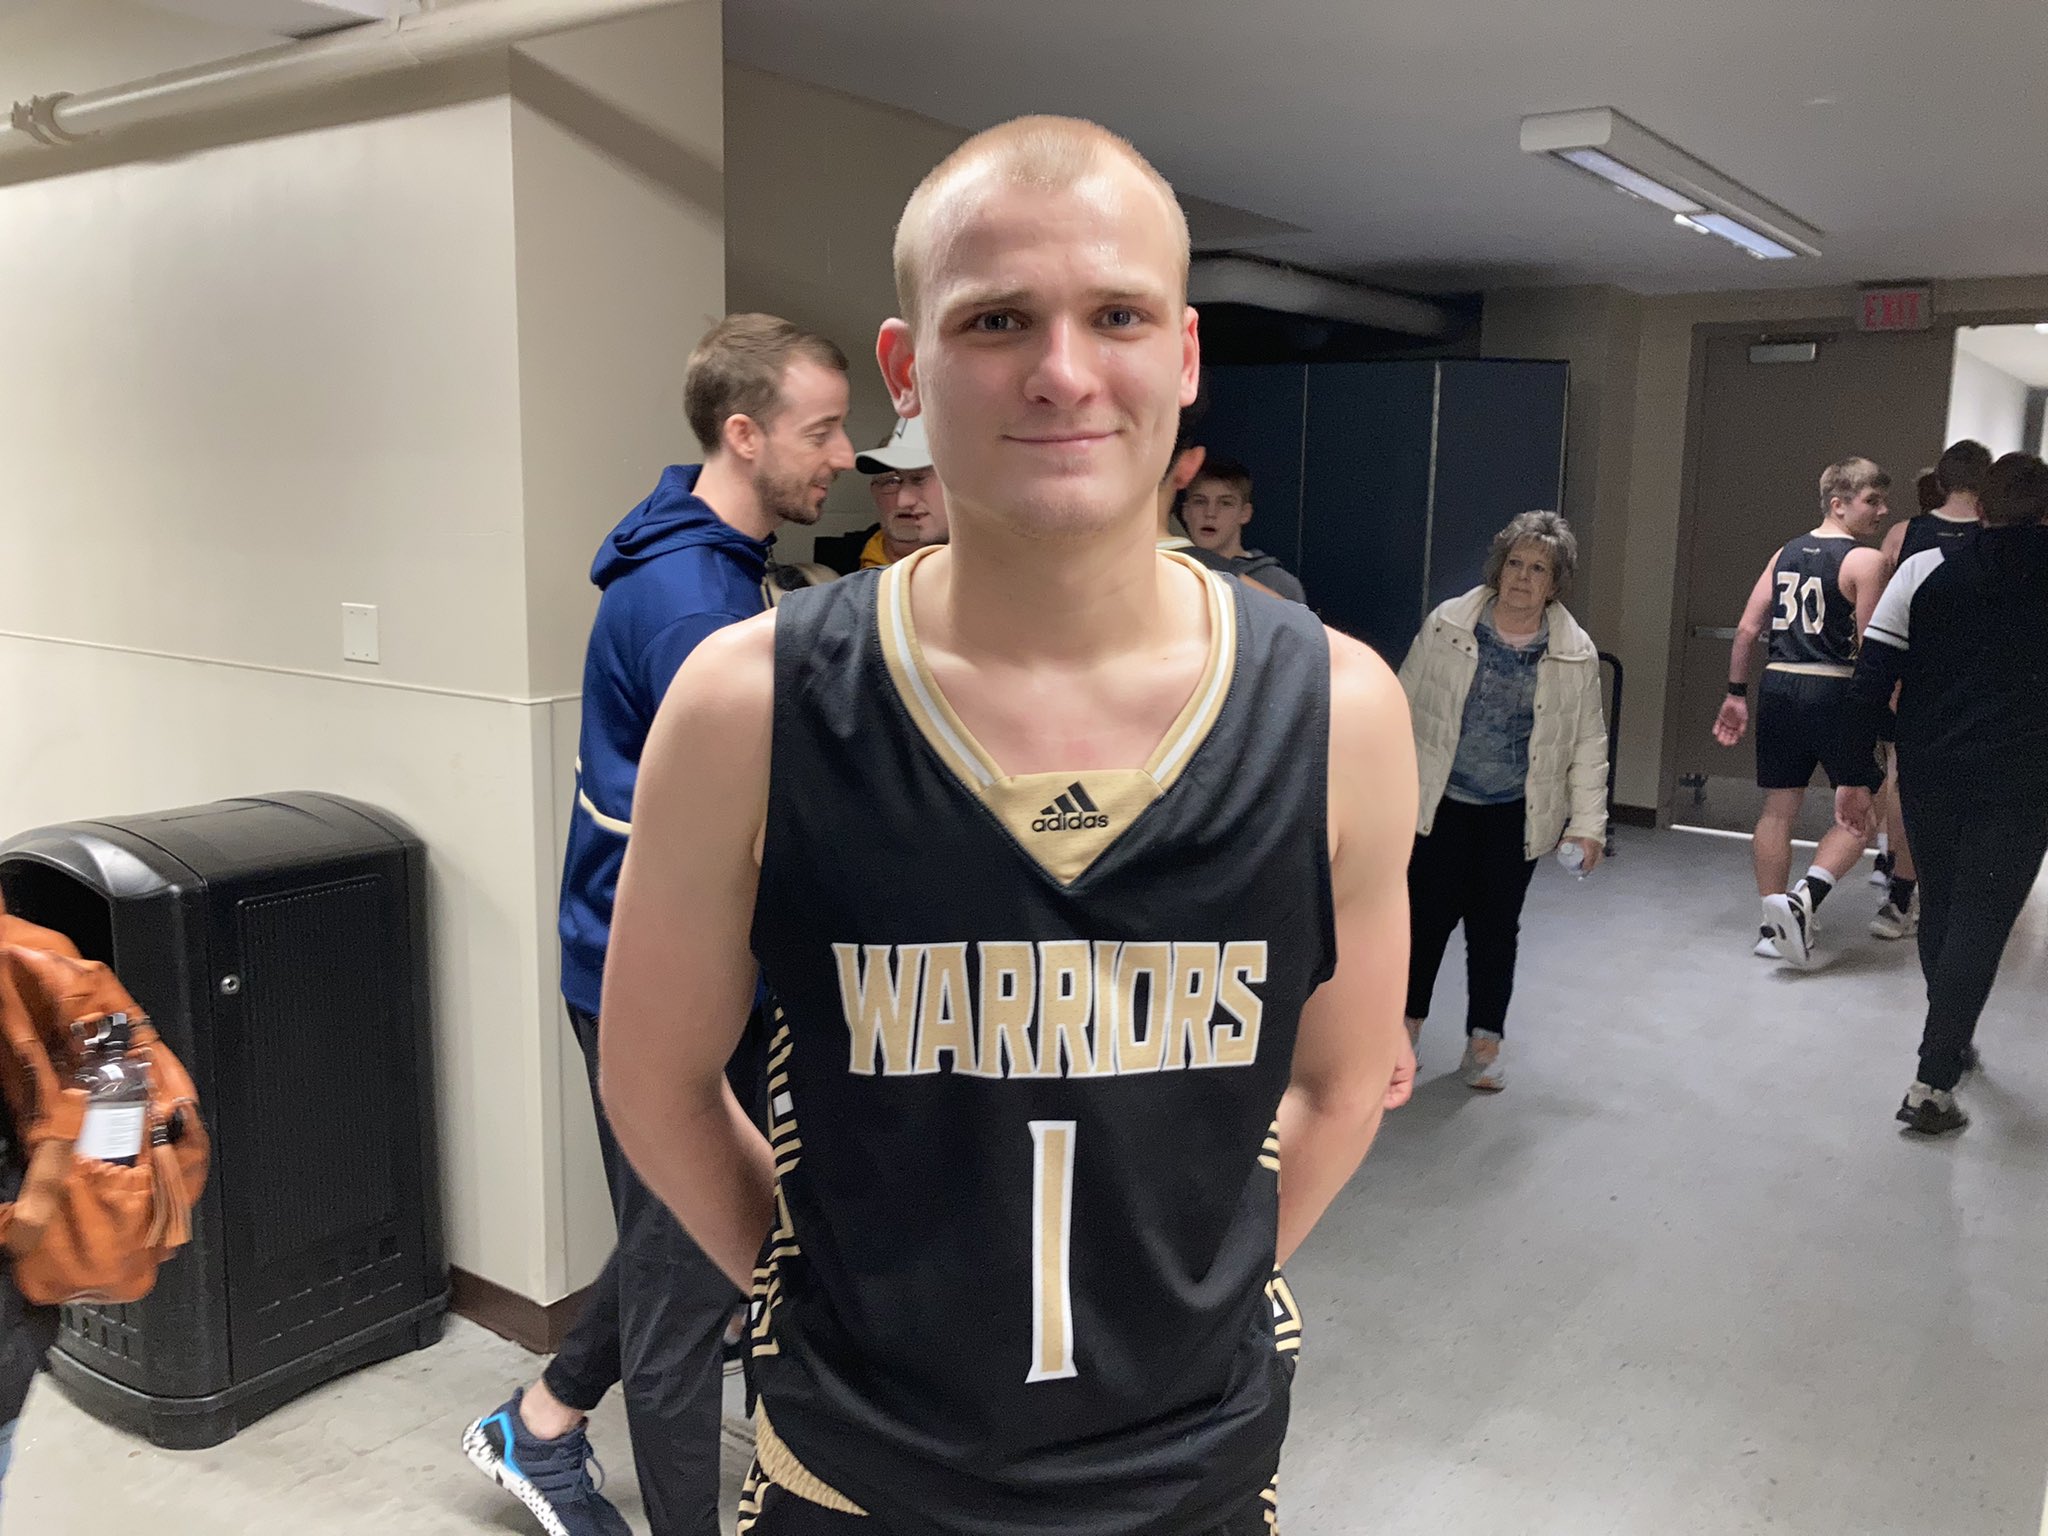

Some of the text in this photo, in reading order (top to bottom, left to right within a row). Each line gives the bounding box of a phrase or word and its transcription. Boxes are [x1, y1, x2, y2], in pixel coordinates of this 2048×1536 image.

[1864, 291, 1920, 329] EXIT
[1772, 571, 1826, 634] 30
[1031, 811, 1109, 832] adidas
[831, 939, 1268, 1079] WARRIORS
[1024, 1120, 1078, 1384] 1
